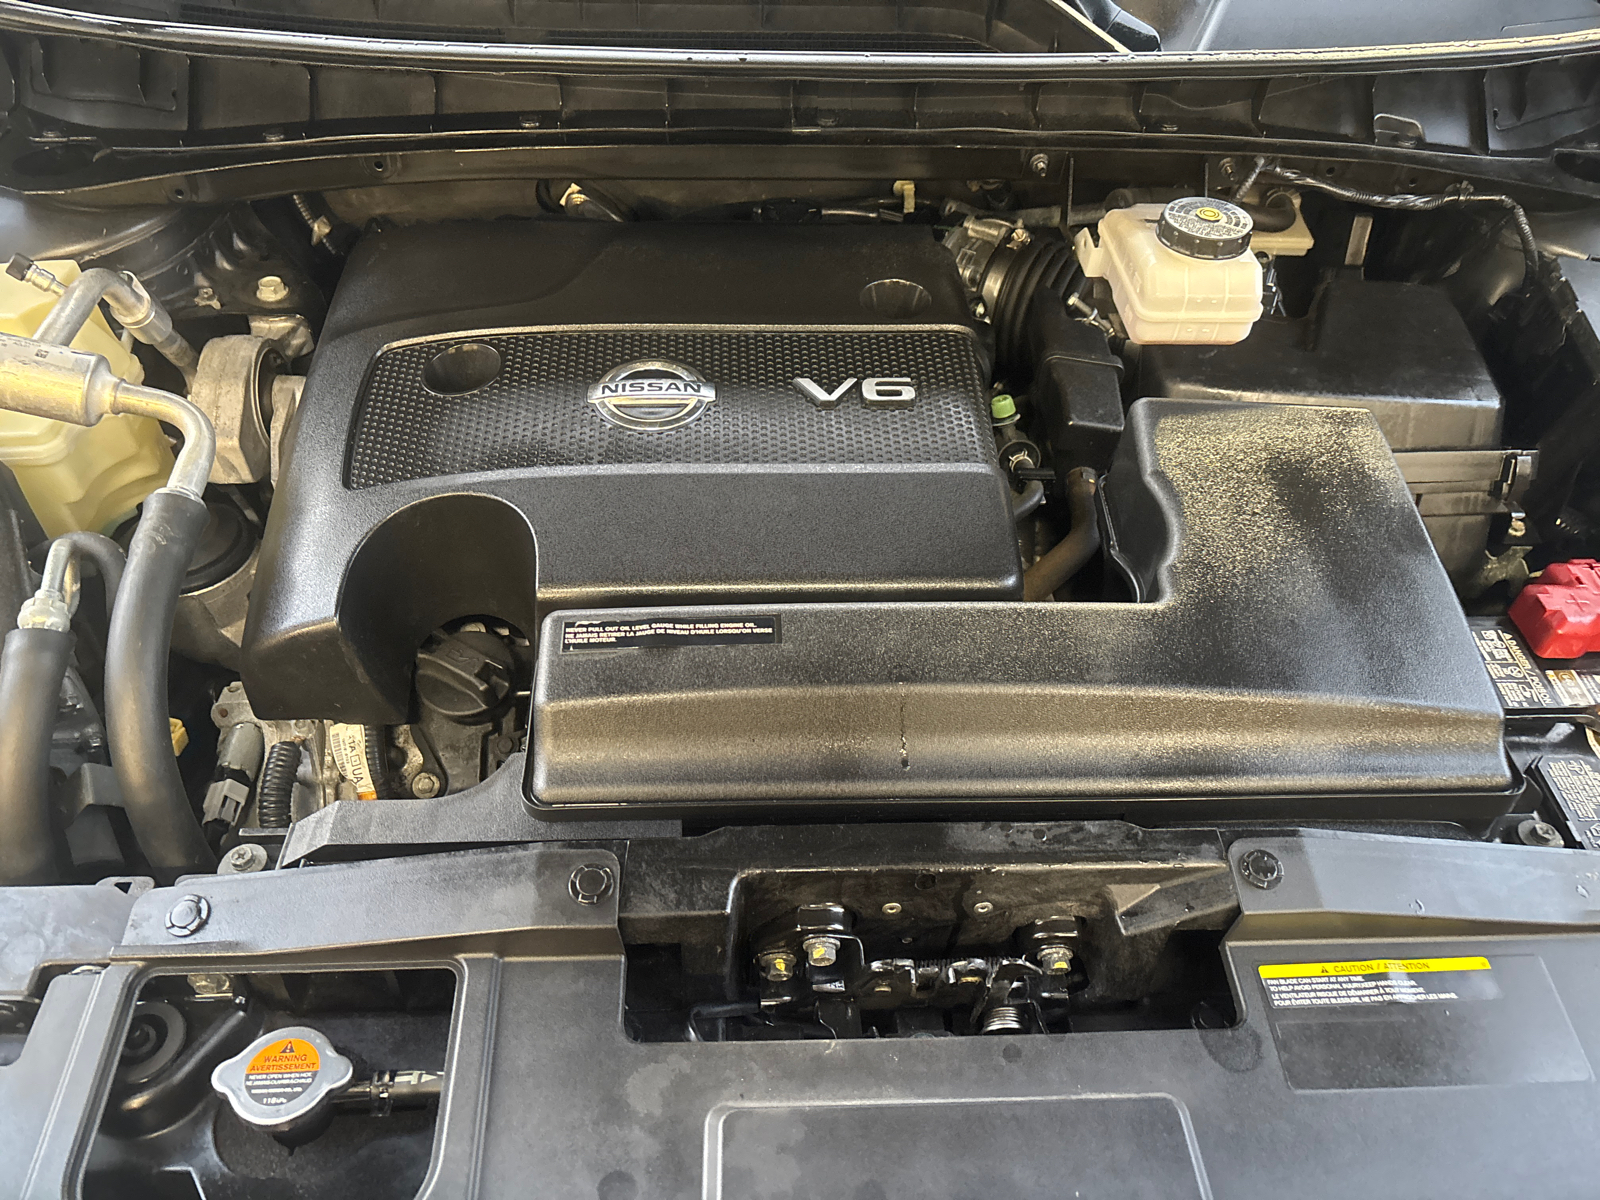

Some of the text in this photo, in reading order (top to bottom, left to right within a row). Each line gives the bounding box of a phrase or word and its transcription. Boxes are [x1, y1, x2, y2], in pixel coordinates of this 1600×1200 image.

[600, 381, 703, 394] NISSAN
[793, 377, 916, 410] V6
[1508, 640, 1532, 669] DANGER
[1530, 676, 1554, 704] POISON
[351, 768, 364, 784] UA
[1333, 963, 1374, 973] CAUTION
[1384, 962, 1430, 970] ATTENTION
[264, 1054, 307, 1063] WARNING
[250, 1062, 316, 1072] AVERTISSEMENT
